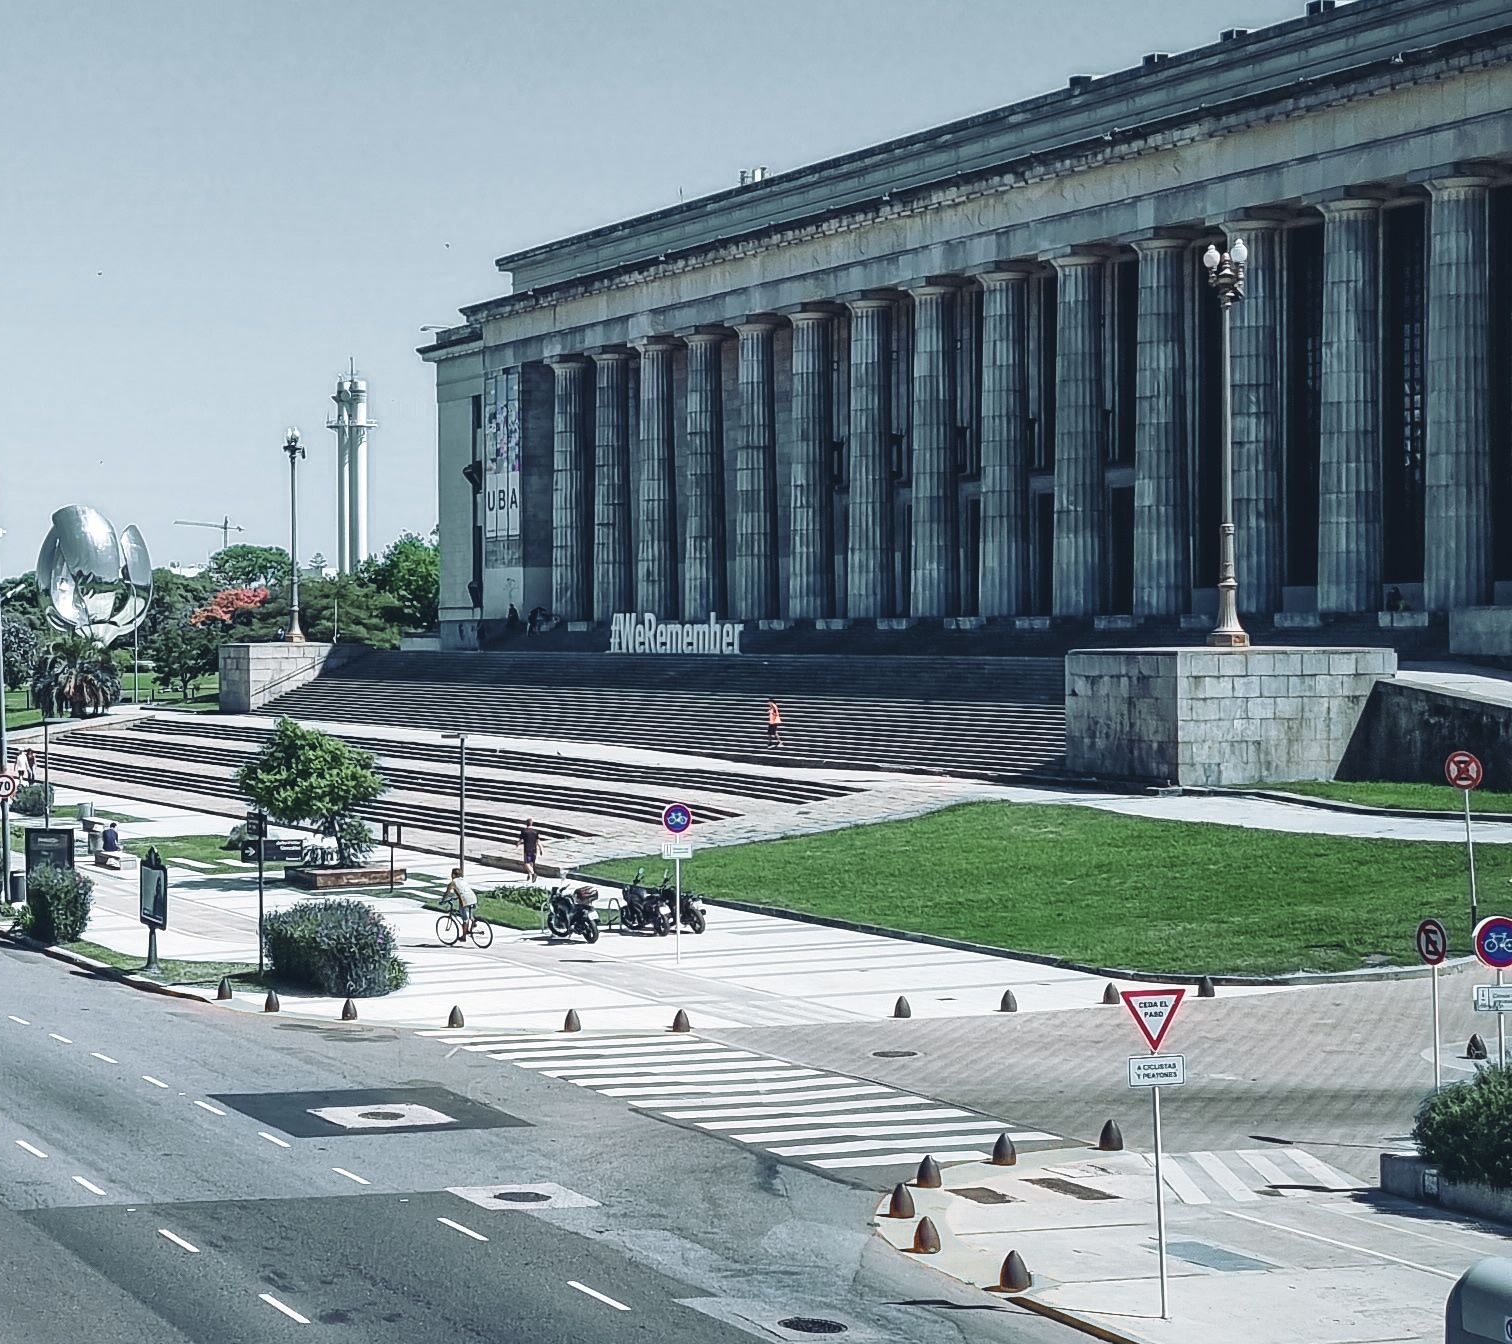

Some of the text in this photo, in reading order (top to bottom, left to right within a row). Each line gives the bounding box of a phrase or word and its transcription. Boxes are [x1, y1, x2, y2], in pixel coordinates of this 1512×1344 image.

[487, 487, 519, 511] UBA
[610, 612, 744, 654] #WeRemember
[1138, 1000, 1169, 1009] CEDA EL
[1143, 1062, 1177, 1071] CICLISTAS
[1142, 1071, 1178, 1079] PEATONES
